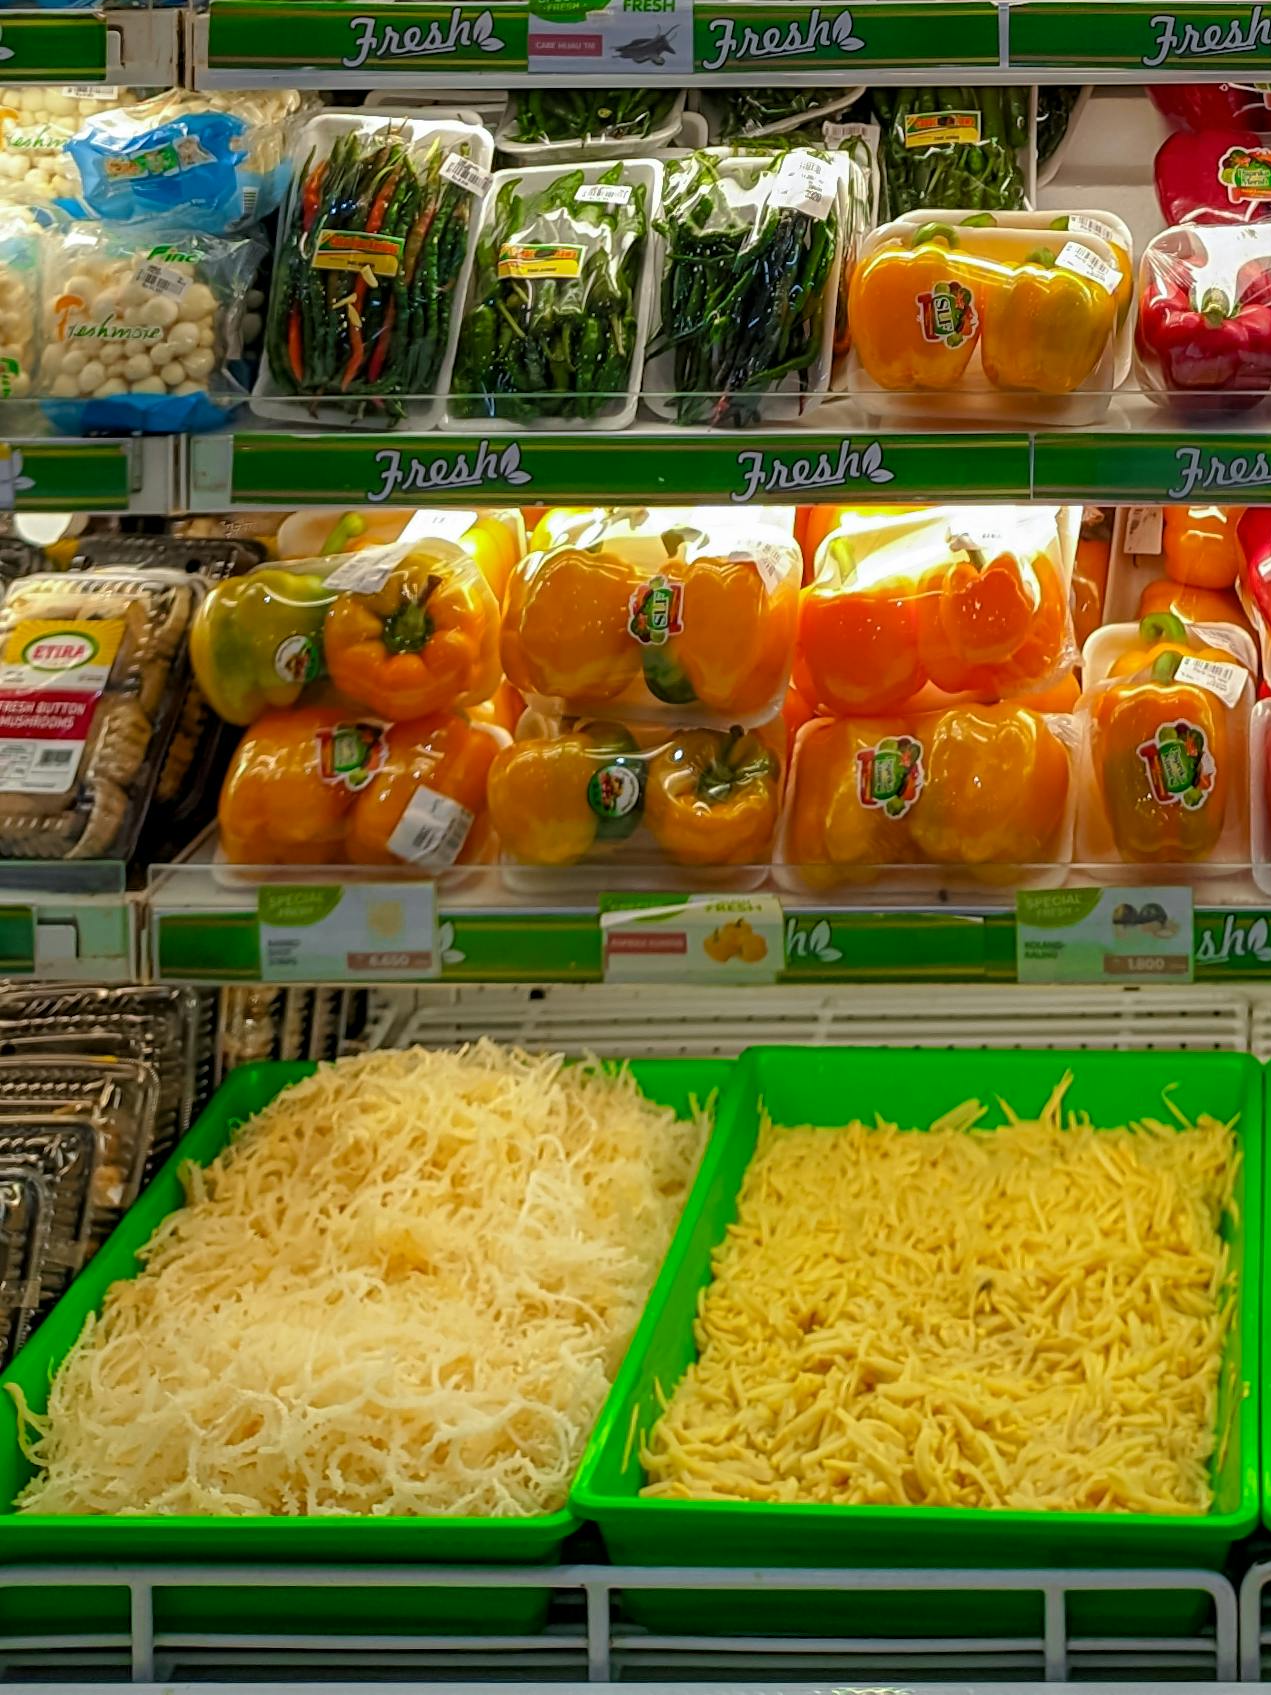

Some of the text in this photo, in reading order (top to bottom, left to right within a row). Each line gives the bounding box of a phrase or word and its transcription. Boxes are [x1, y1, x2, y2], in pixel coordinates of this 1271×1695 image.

[342, 9, 472, 68] Fresh
[535, 40, 557, 50] CABE
[702, 9, 832, 70] Fresh
[367, 441, 500, 501] Fresh
[730, 440, 861, 502] Fresh
[32, 644, 87, 659] ETIRA
[35, 701, 87, 715] BUTTON
